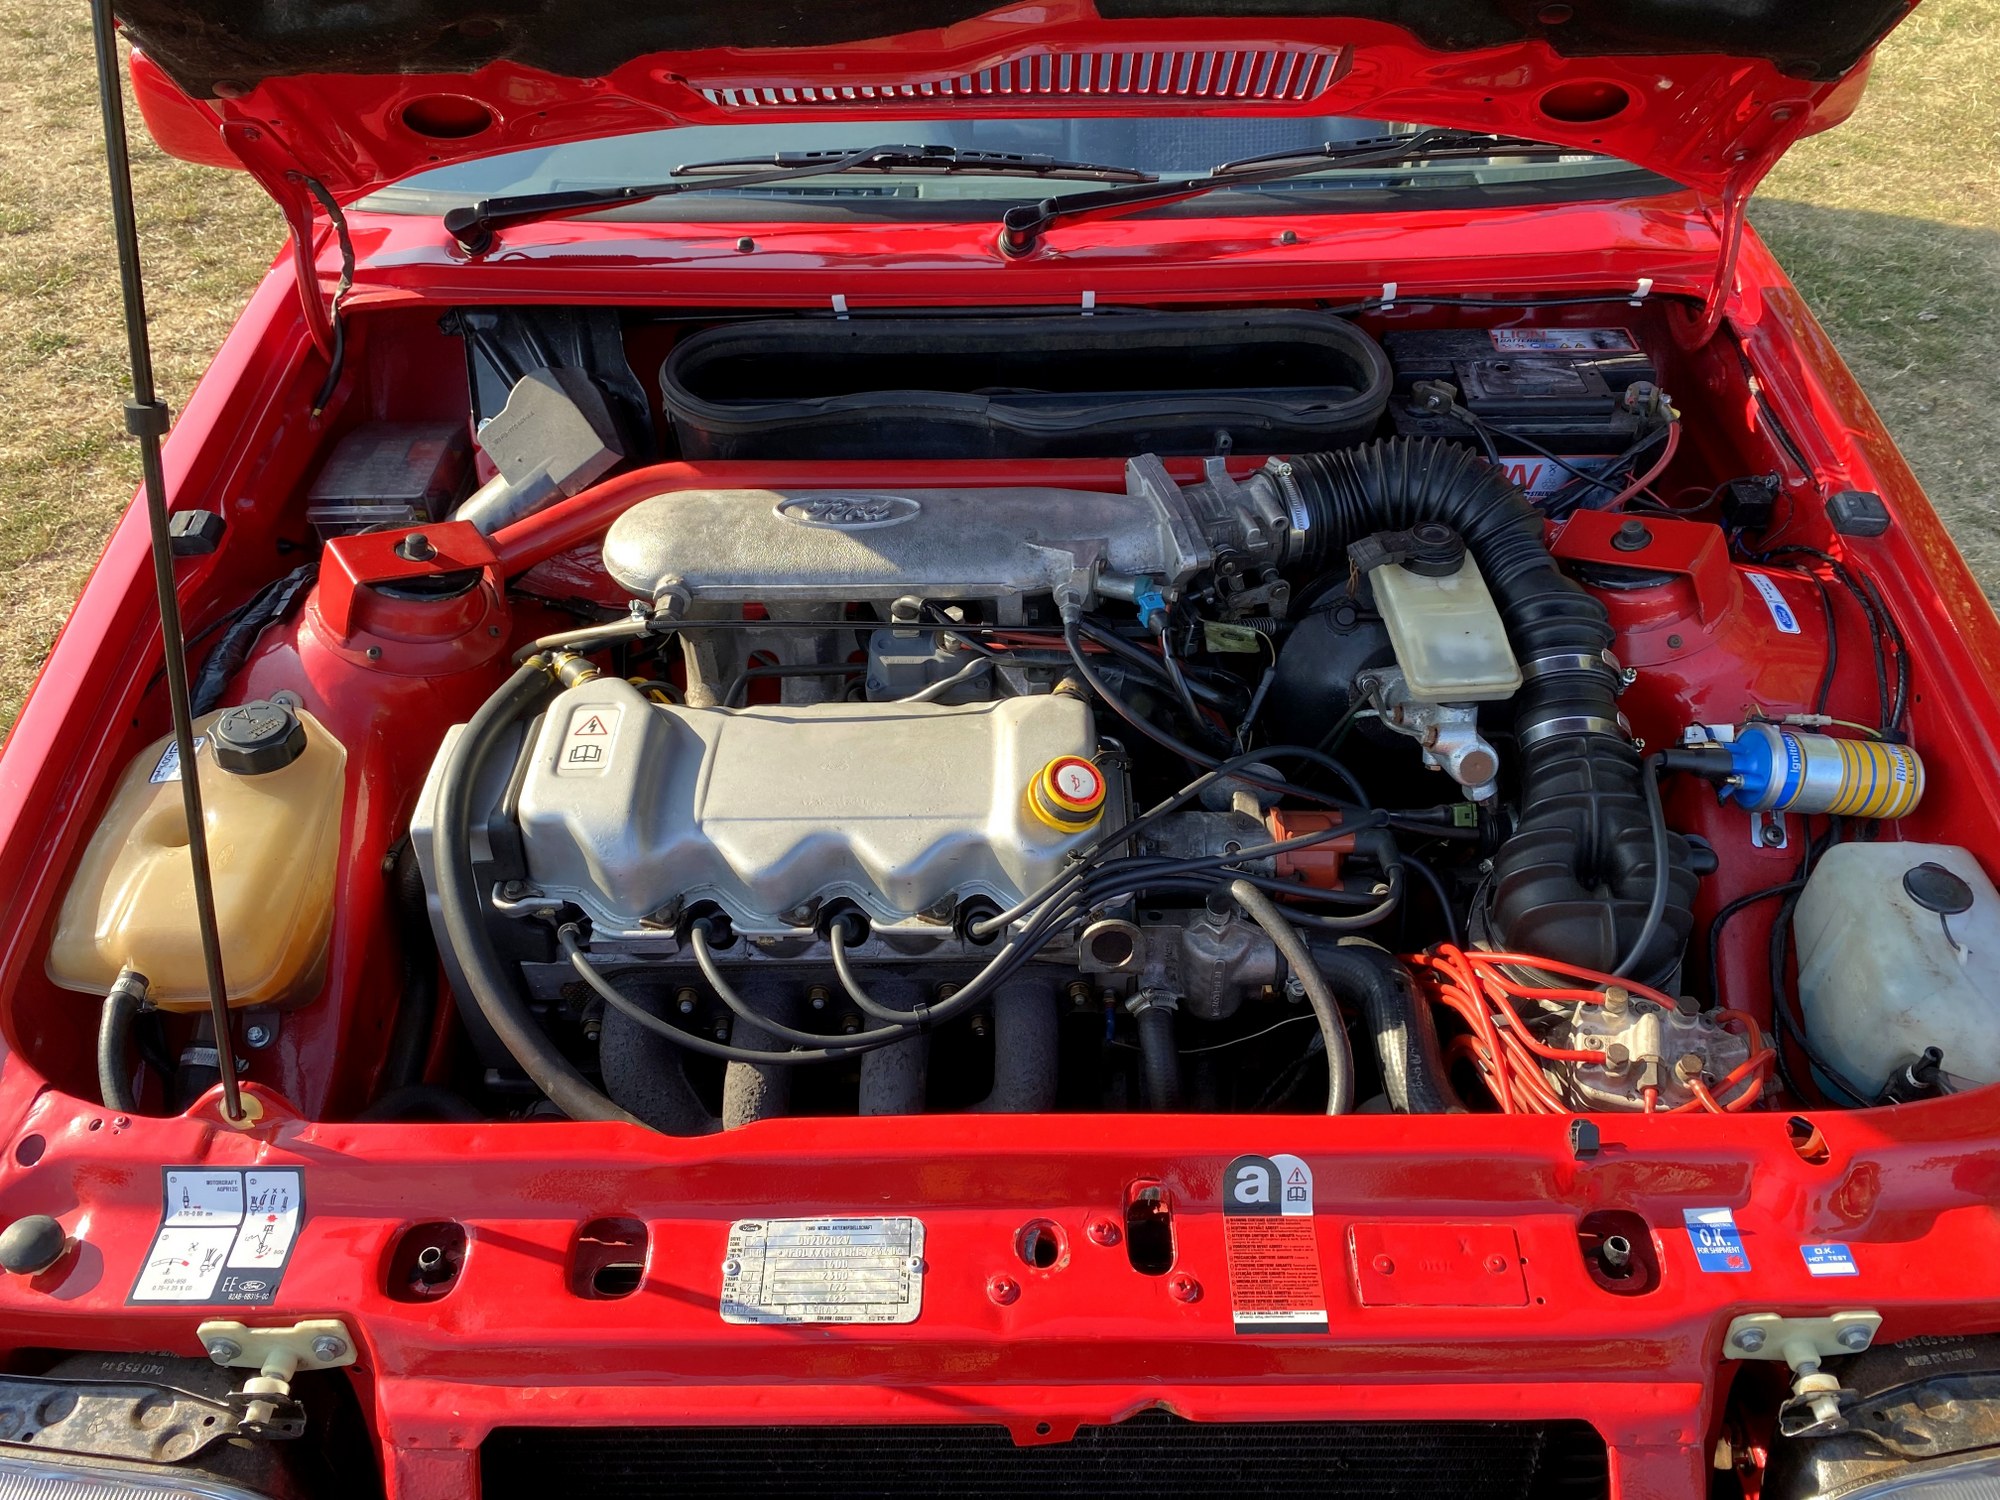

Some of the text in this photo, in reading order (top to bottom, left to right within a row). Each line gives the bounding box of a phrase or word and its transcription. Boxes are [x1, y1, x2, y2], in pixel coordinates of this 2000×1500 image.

[1233, 1165, 1270, 1204] a
[1699, 1228, 1732, 1247] O.K.
[1697, 1246, 1741, 1254] FOR SHIPMENT
[1814, 1247, 1836, 1255] O.K.
[221, 1276, 239, 1293] EE
